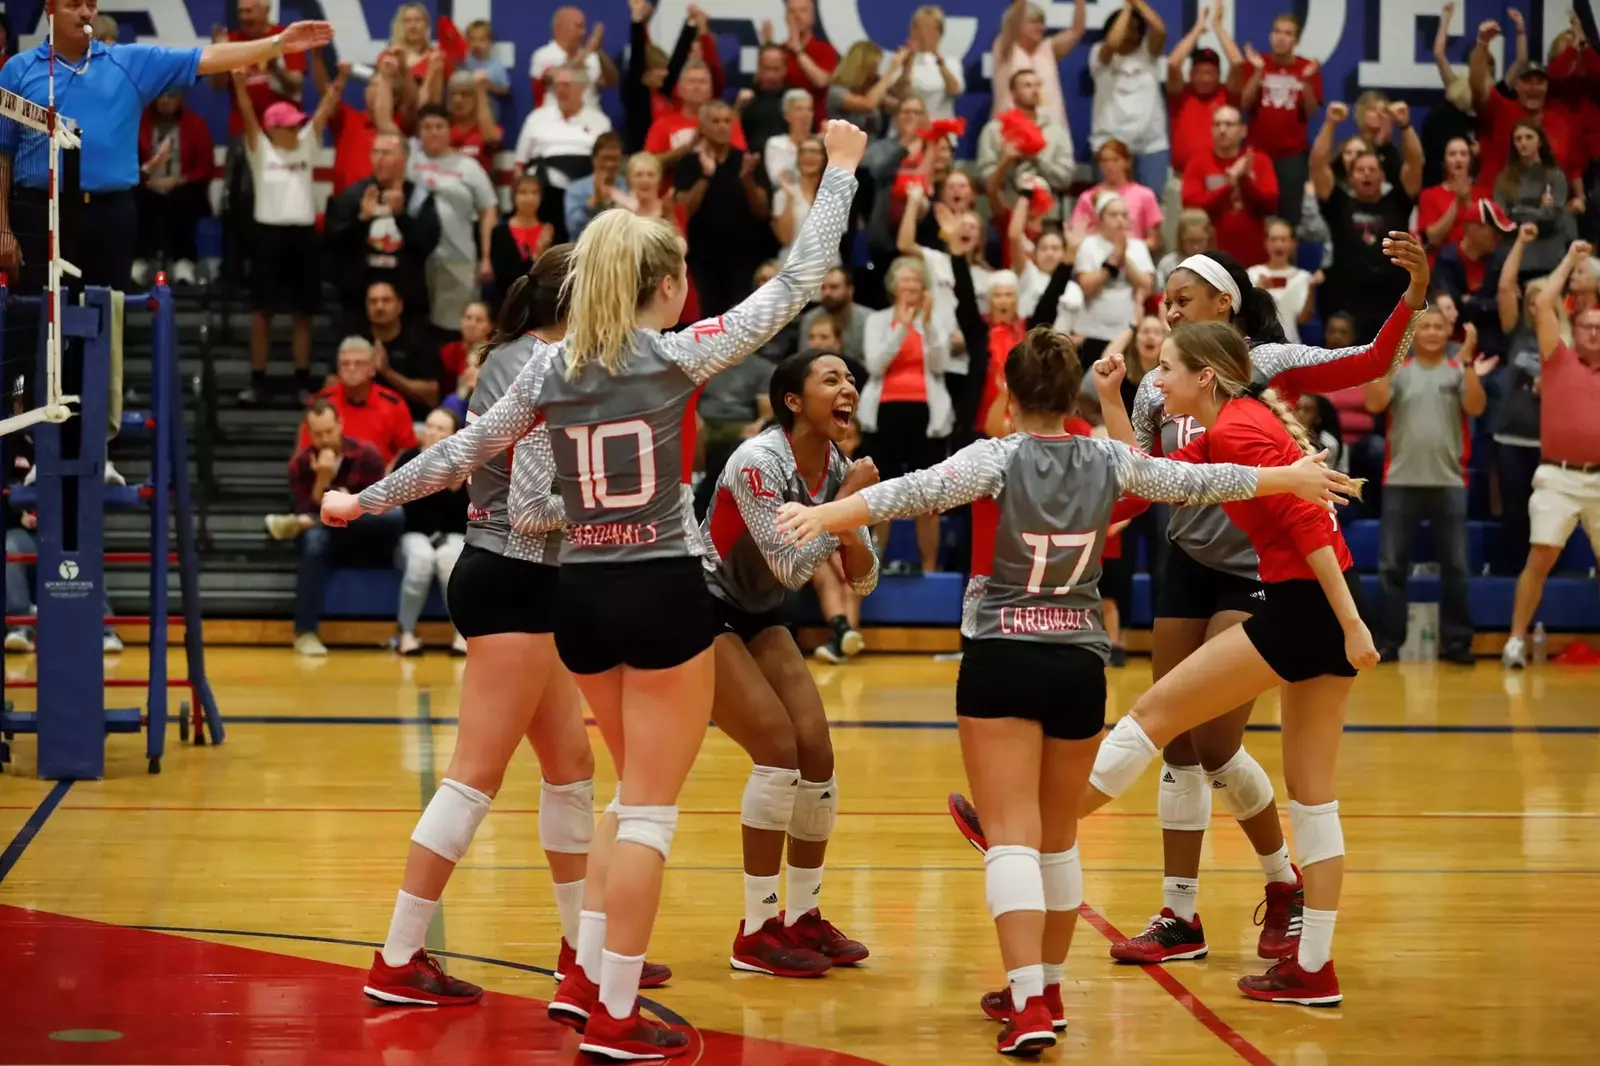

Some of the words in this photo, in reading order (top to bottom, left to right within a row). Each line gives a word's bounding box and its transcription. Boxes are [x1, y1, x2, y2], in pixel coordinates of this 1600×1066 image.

[564, 418, 656, 510] 10
[1021, 529, 1097, 595] 17
[1000, 606, 1094, 635] CARDINALS
